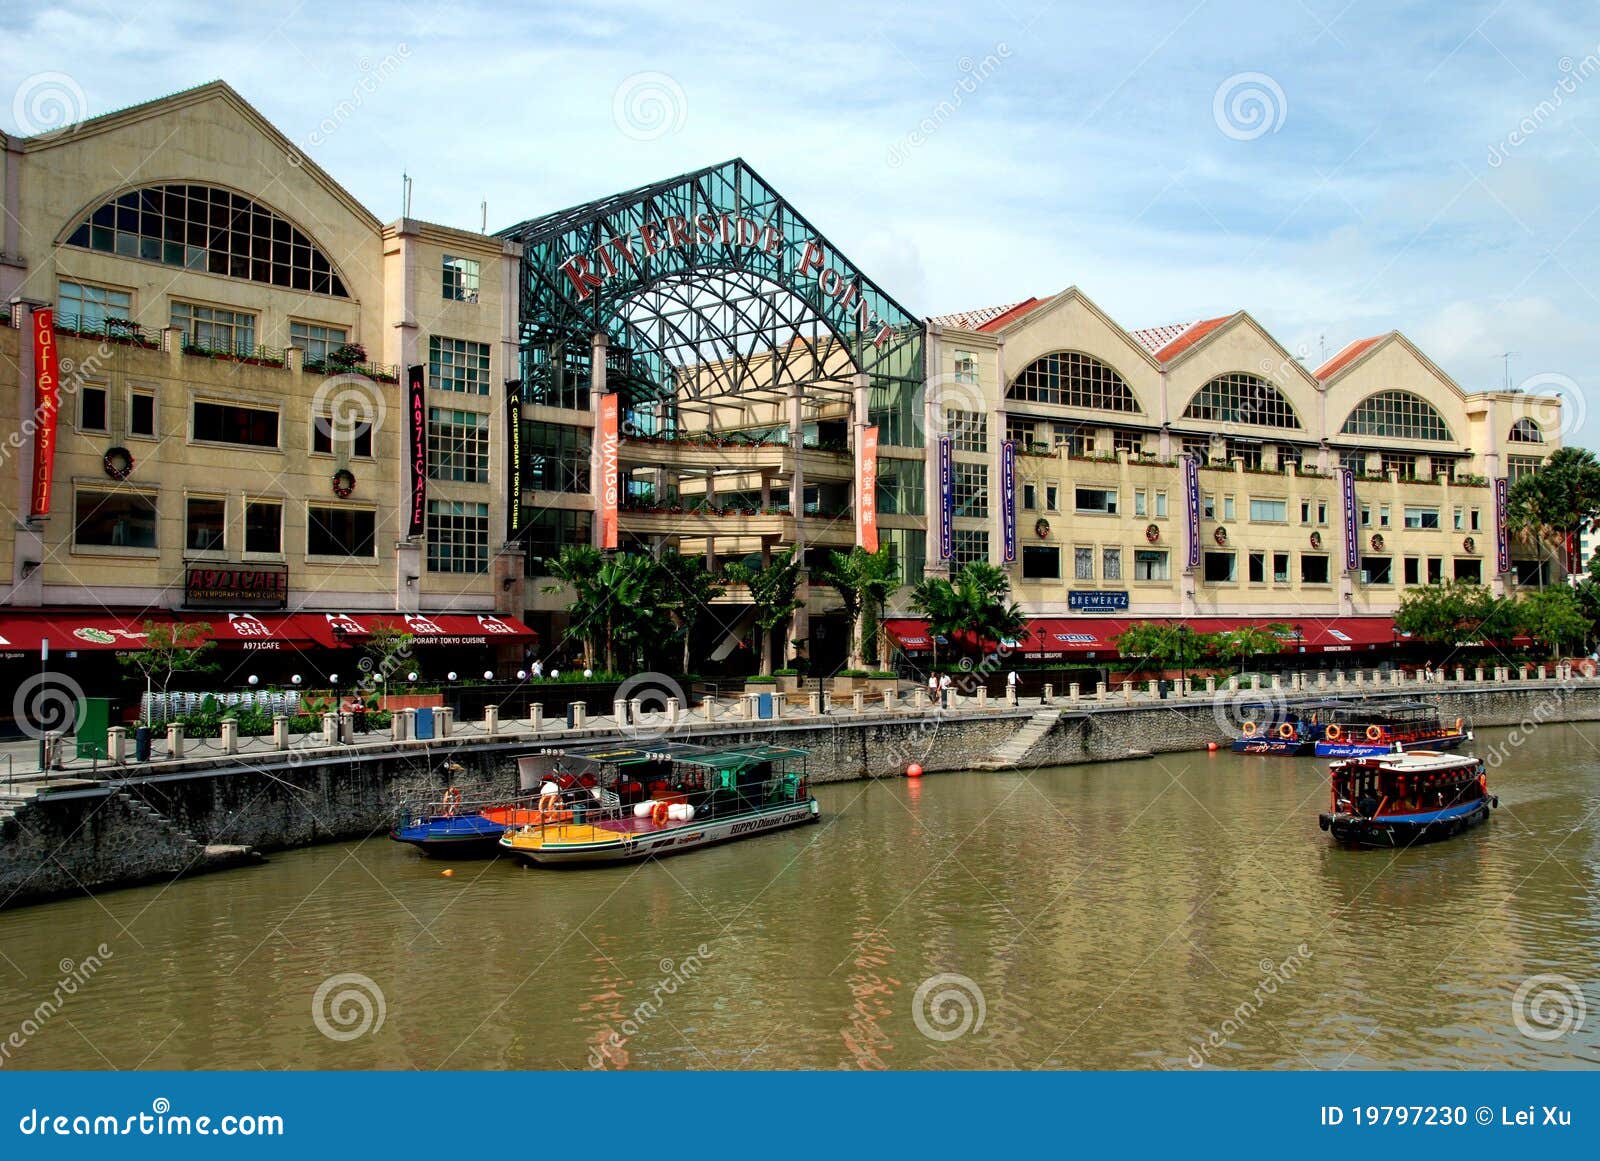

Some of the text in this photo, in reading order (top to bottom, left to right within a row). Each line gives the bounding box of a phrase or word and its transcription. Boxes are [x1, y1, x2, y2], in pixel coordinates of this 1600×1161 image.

[558, 212, 785, 303] RIVERSIDE
[512, 407, 520, 469] CONTEMPORARY
[413, 394, 425, 524] A971CAFE
[1071, 596, 1127, 605] BREWERKZ
[243, 641, 280, 650] A971CAFE
[386, 637, 438, 645] CONEMPORARY
[730, 821, 758, 835] HIPPO
